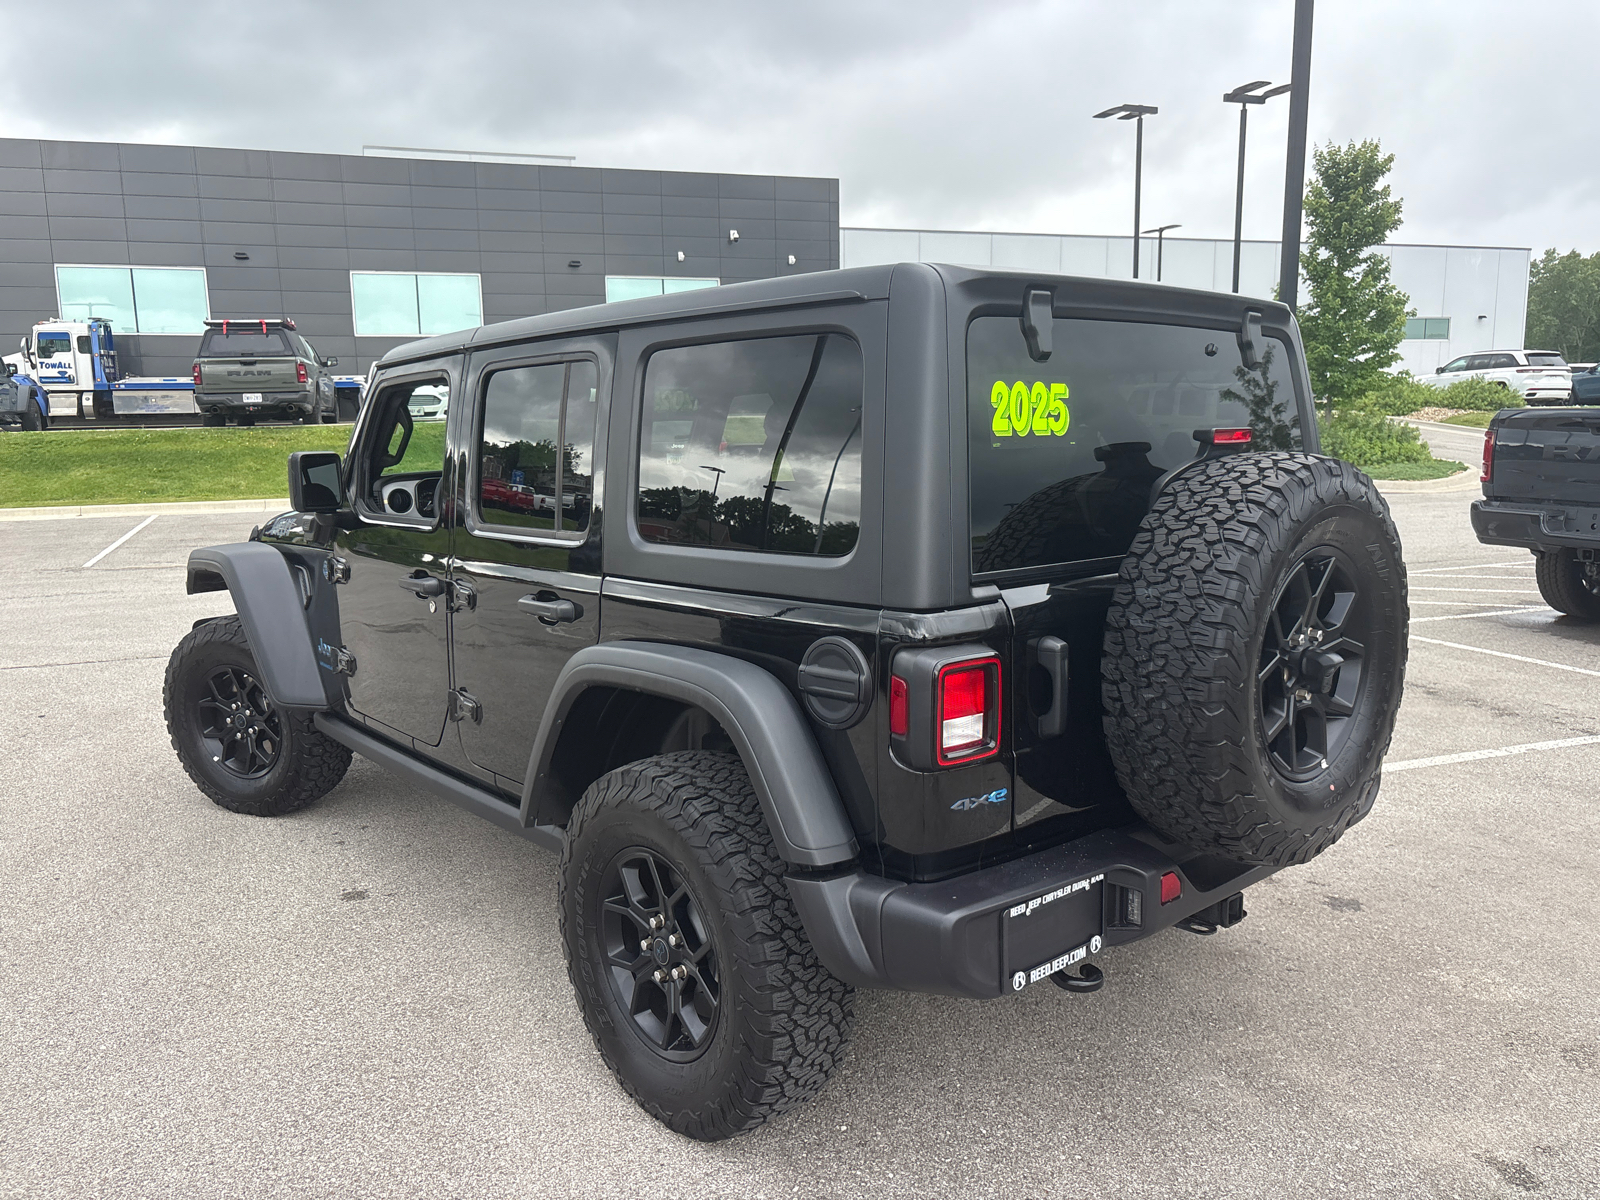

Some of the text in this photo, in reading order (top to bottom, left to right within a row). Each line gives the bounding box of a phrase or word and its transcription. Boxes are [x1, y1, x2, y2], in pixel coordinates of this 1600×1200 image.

[991, 381, 1070, 437] 2025
[1010, 904, 1026, 918] REED
[1042, 885, 1071, 904] CHRYSLER
[1030, 945, 1087, 984] REEDJEEP.COM
